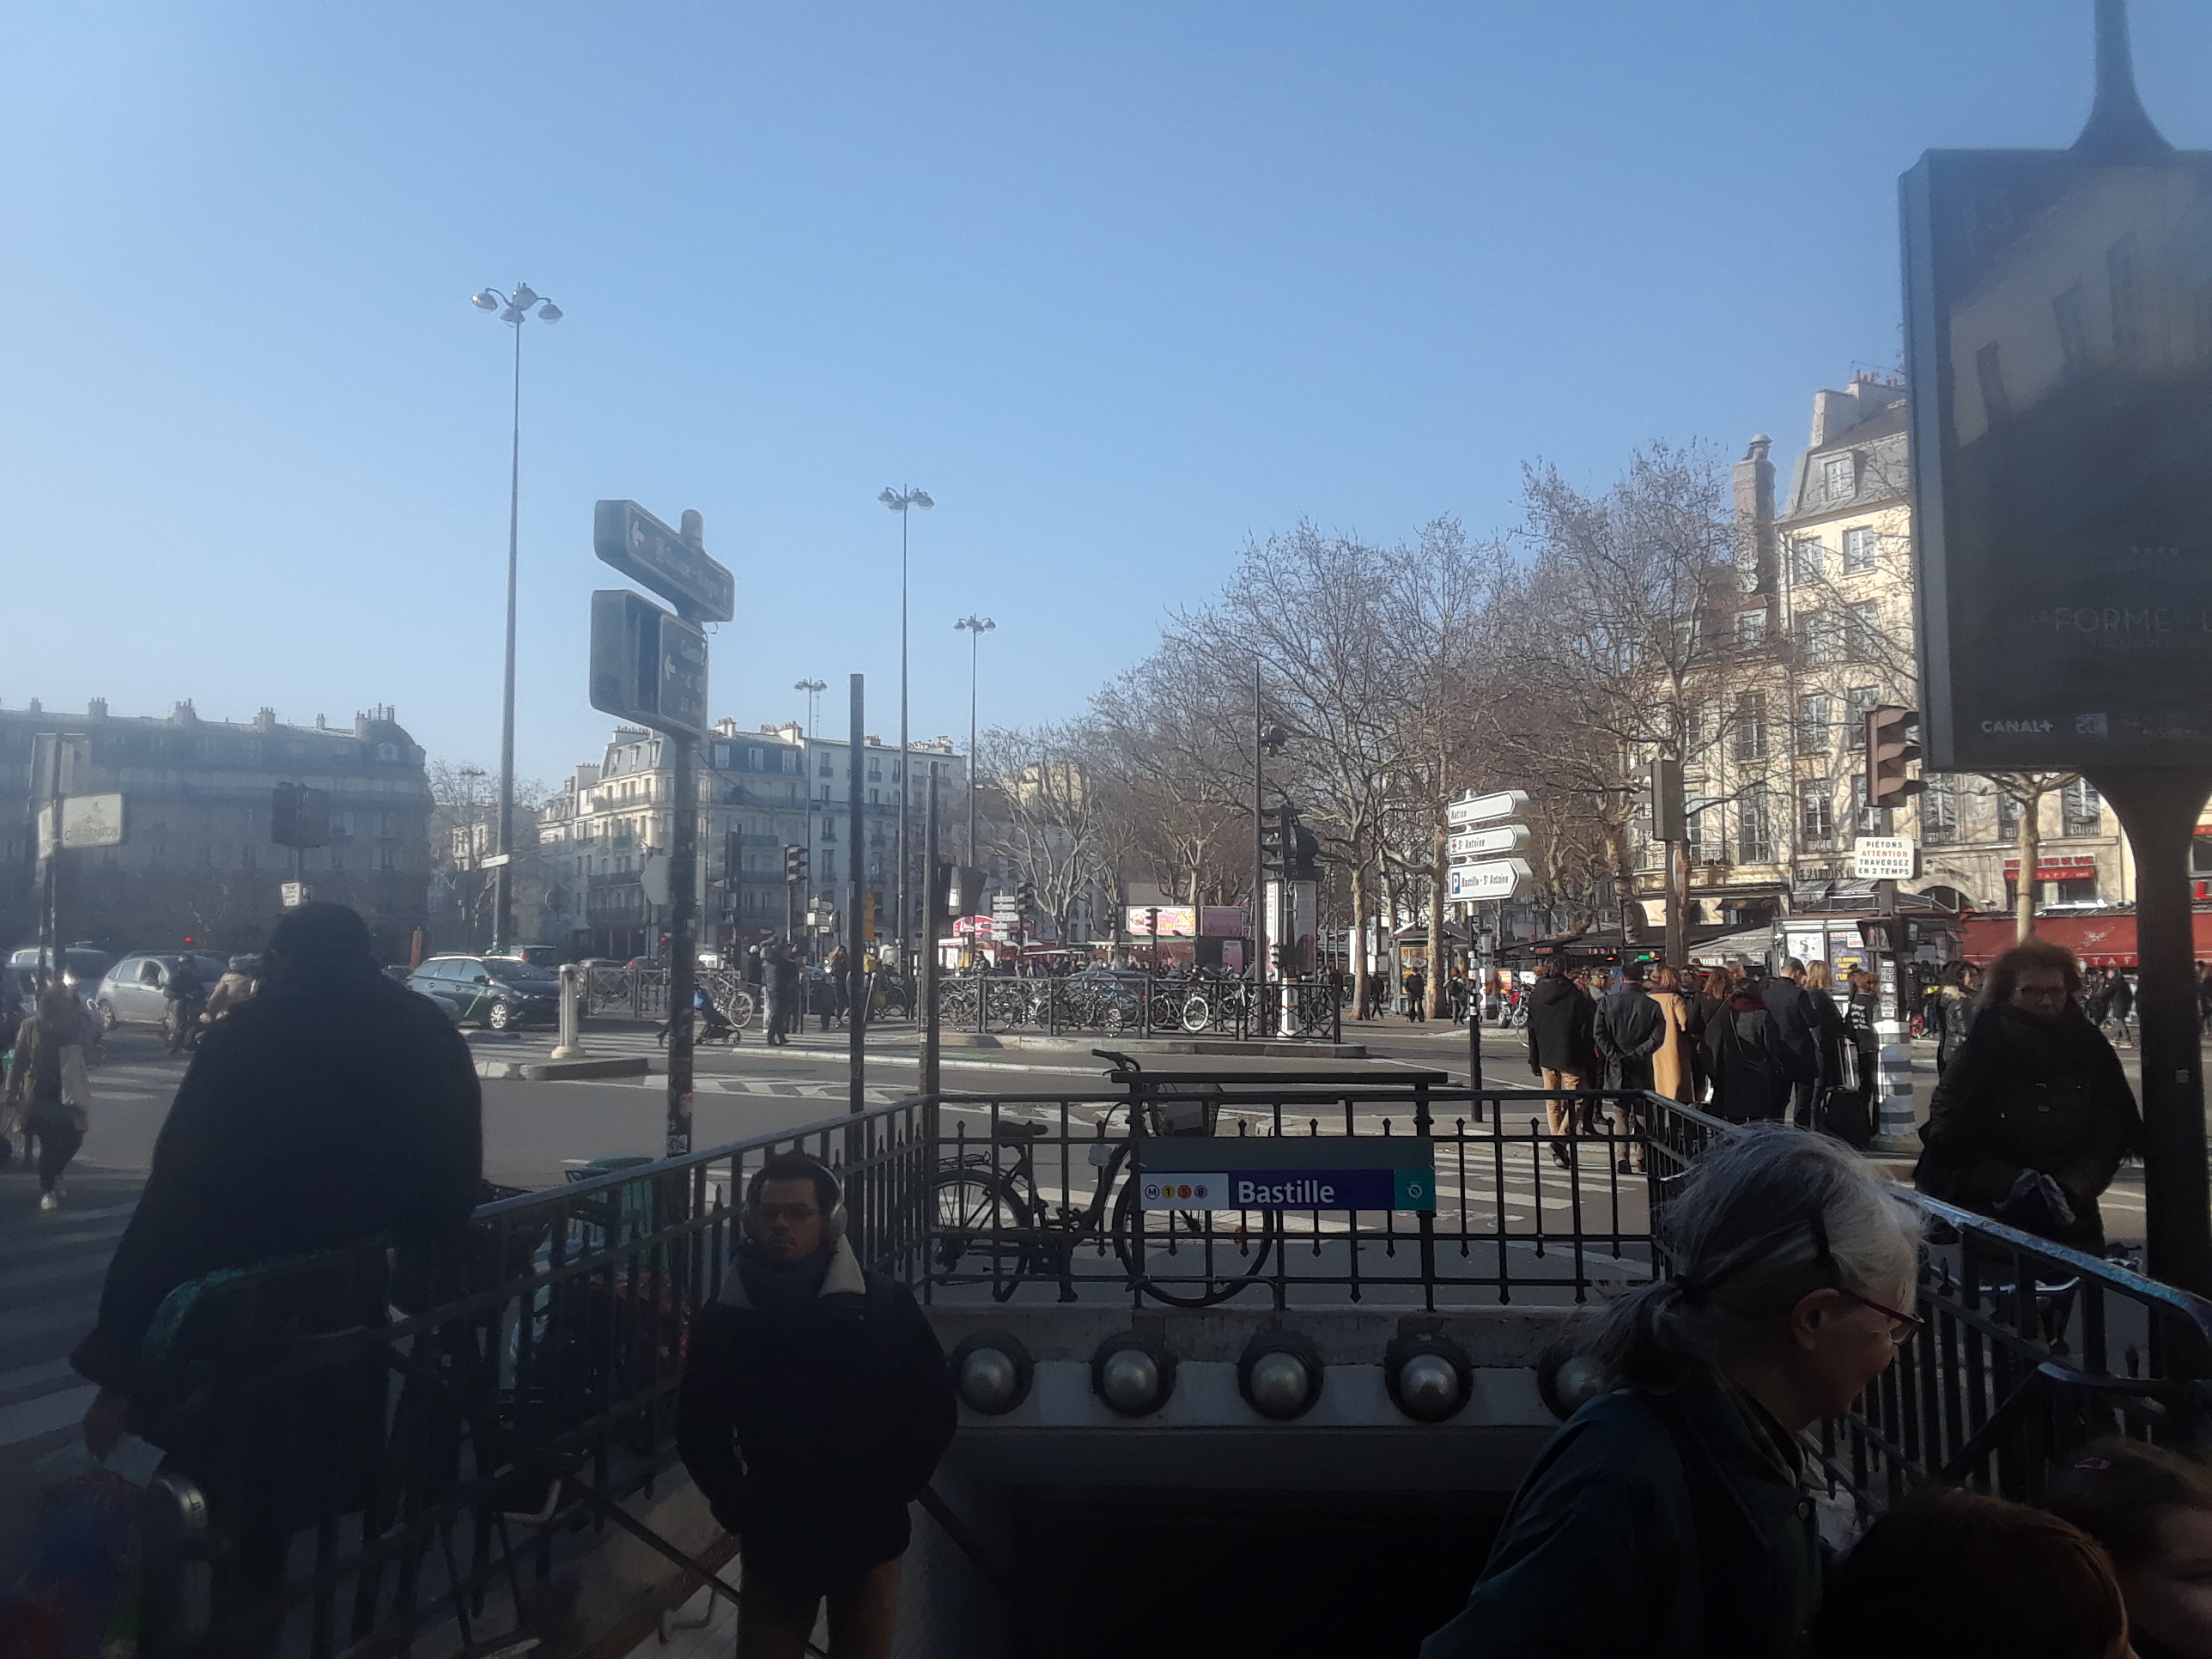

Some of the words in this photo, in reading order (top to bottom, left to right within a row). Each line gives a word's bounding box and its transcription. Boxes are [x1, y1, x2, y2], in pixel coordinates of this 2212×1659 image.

[2054, 607, 2171, 632] FORME
[1980, 720, 2053, 733] CANAL+
[1451, 810, 1467, 820] Nation
[1465, 837, 1485, 848] Antoine
[1462, 876, 1479, 888] Bastille
[1490, 873, 1509, 885] Antoine
[1237, 1180, 1334, 1204] Bastille
